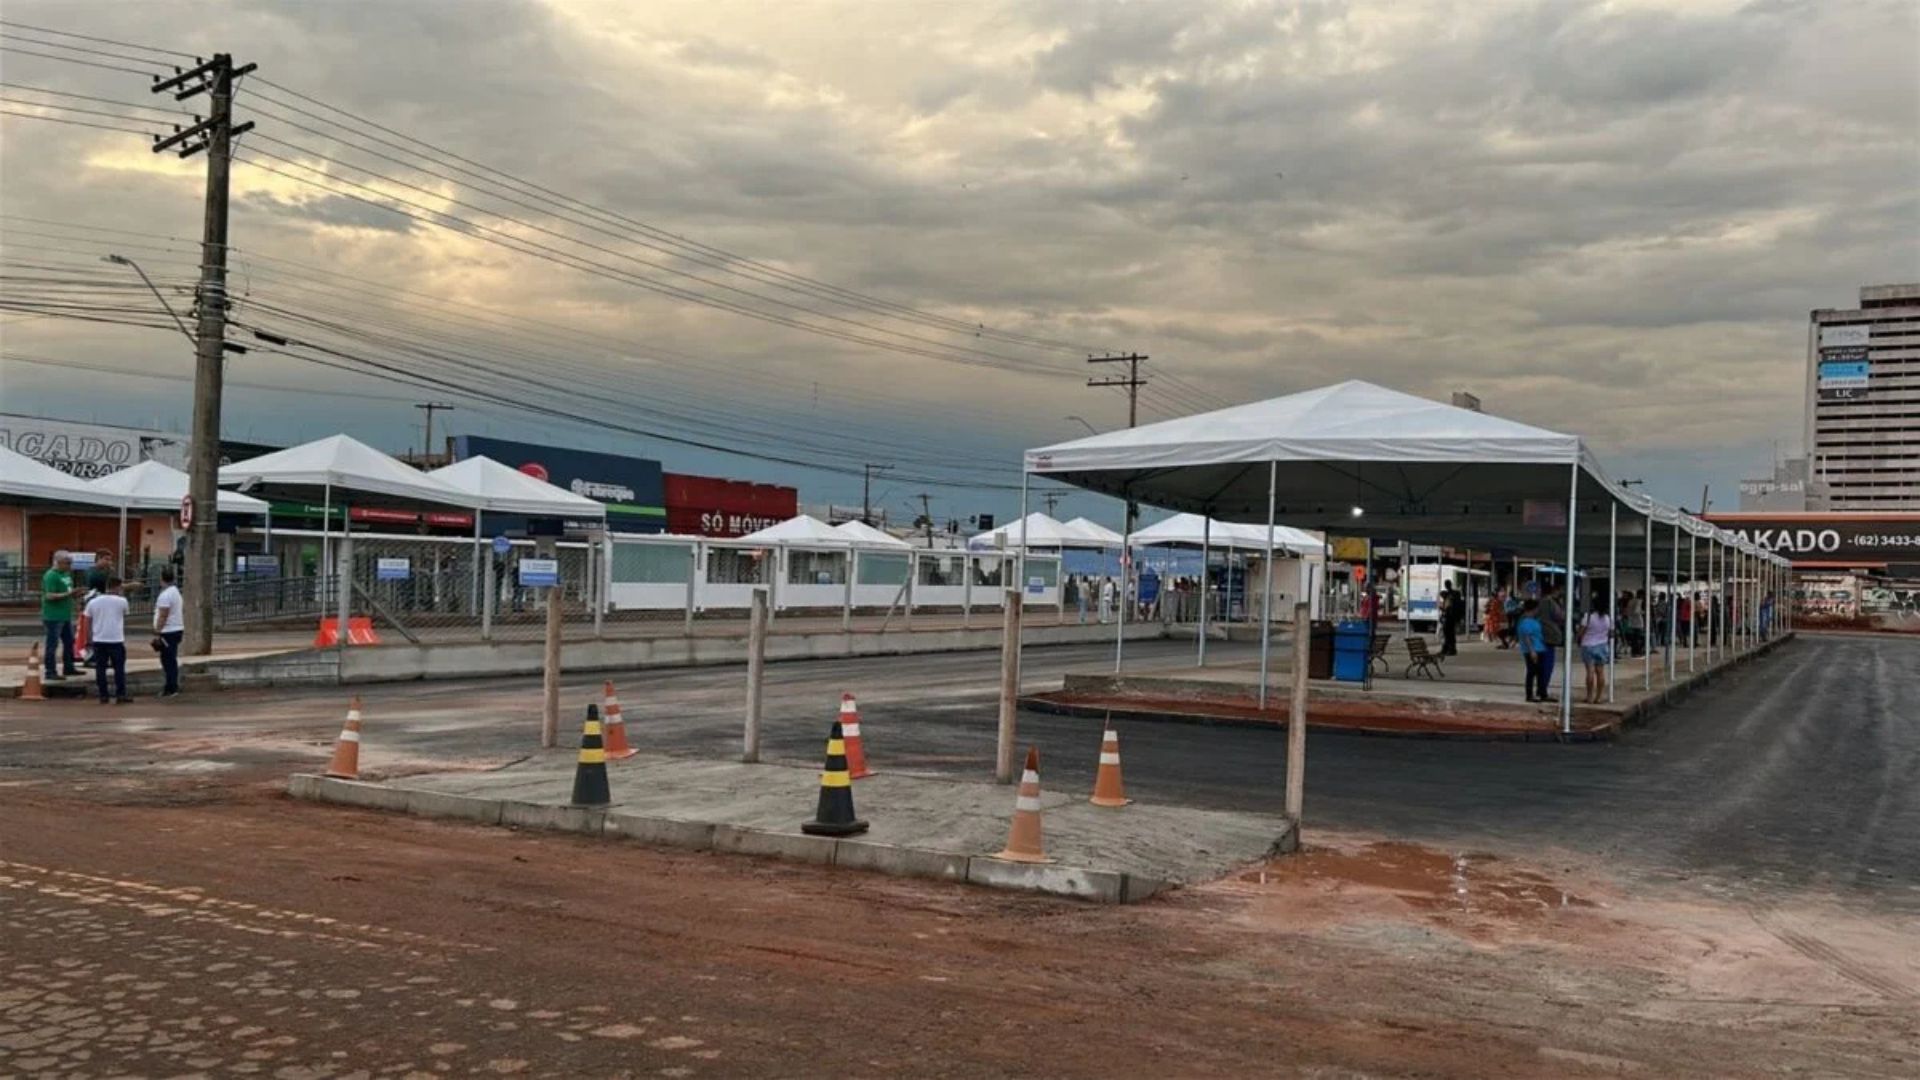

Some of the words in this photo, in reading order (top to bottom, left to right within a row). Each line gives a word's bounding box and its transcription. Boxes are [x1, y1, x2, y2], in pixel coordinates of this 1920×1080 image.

[702, 509, 723, 532] SÓ
[729, 513, 783, 535] MÓVE
[1721, 529, 1841, 552] AKADO
[1854, 534, 1879, 547] (62)
